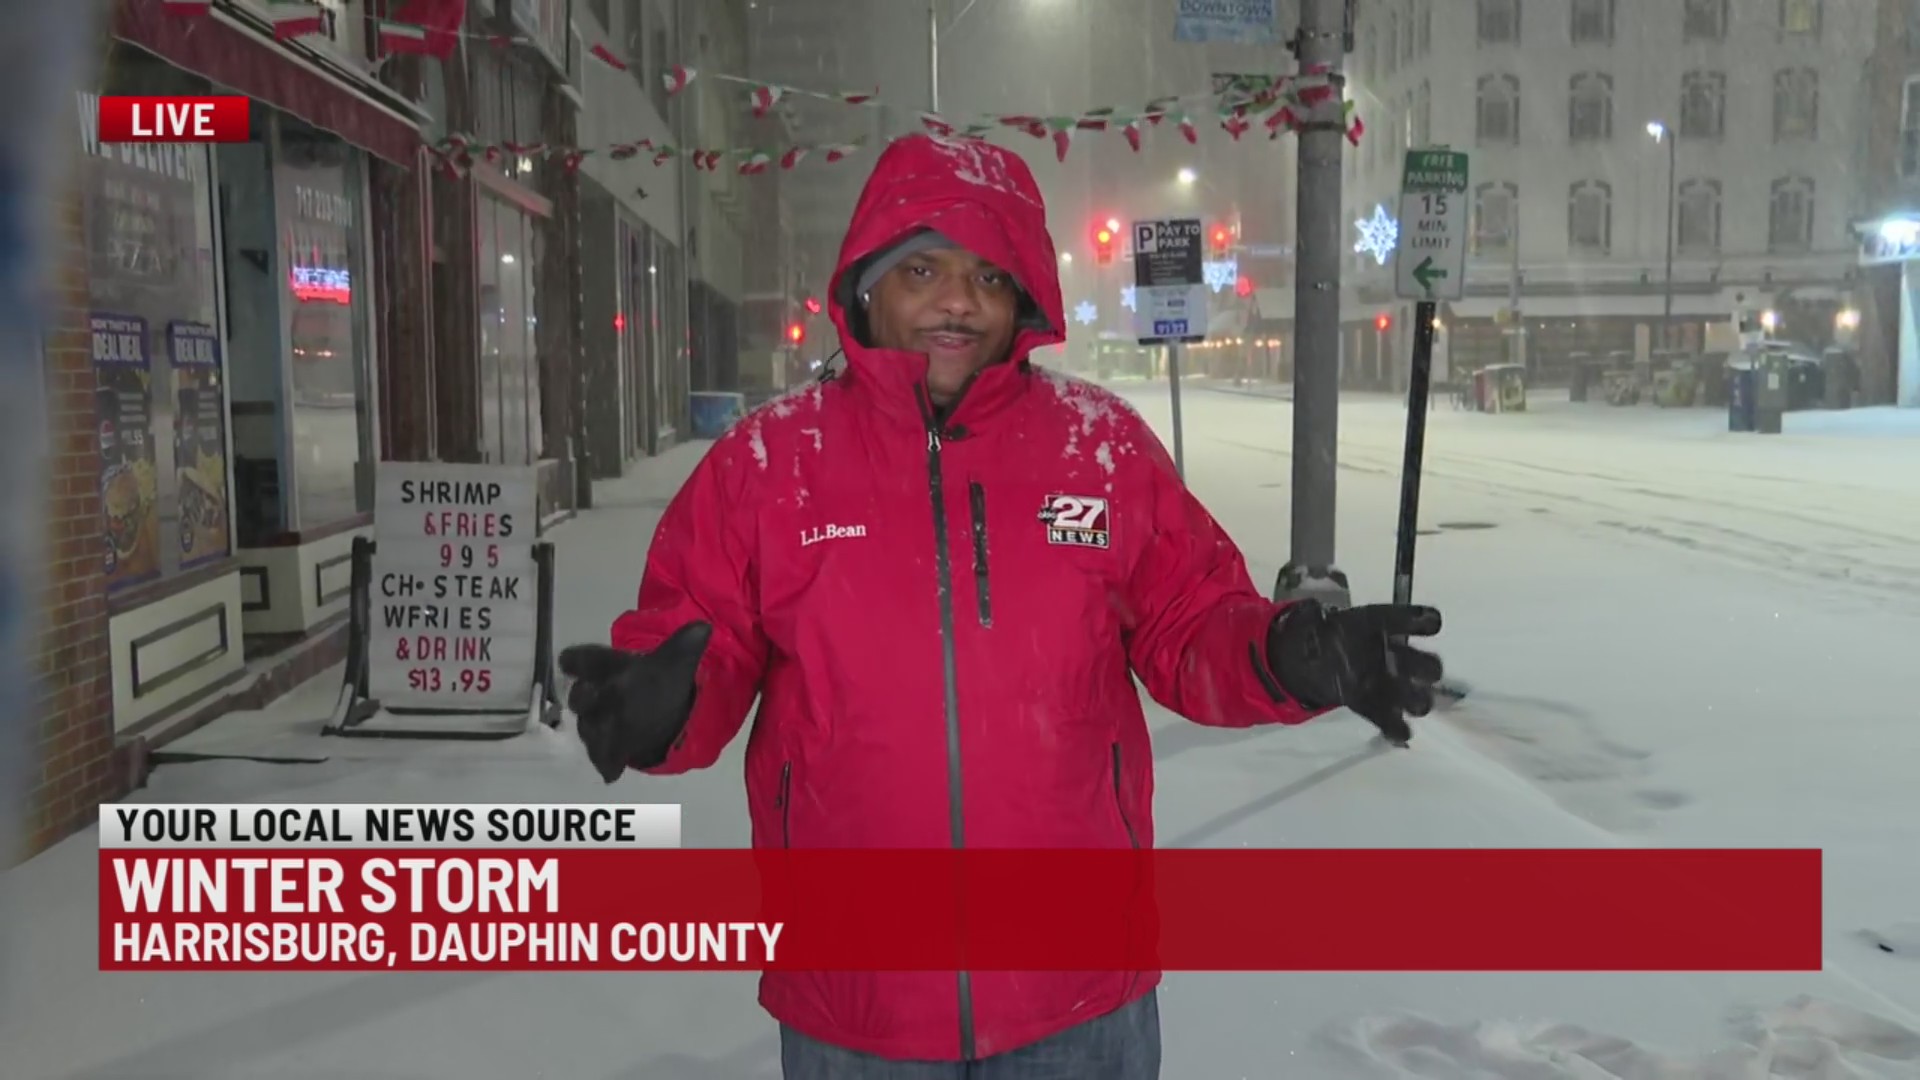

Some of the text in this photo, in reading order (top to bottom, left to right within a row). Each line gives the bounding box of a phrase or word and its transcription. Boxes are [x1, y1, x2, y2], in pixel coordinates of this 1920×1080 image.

[1179, 0, 1272, 17] DOWNTOWN
[1422, 154, 1454, 168] FREE
[1408, 171, 1466, 187] PARKING
[1421, 194, 1448, 216] 15
[1158, 224, 1201, 237] PAY TO
[1418, 220, 1448, 232] MIN
[1138, 226, 1153, 250] P
[1158, 238, 1190, 248] PARK
[1411, 237, 1451, 249] LIMIT
[402, 480, 501, 505] SHRIMP
[1052, 496, 1105, 528] 27
[801, 523, 867, 546] L.L.Bean
[1052, 530, 1106, 546] NEWS
[434, 575, 519, 599] STEAK
